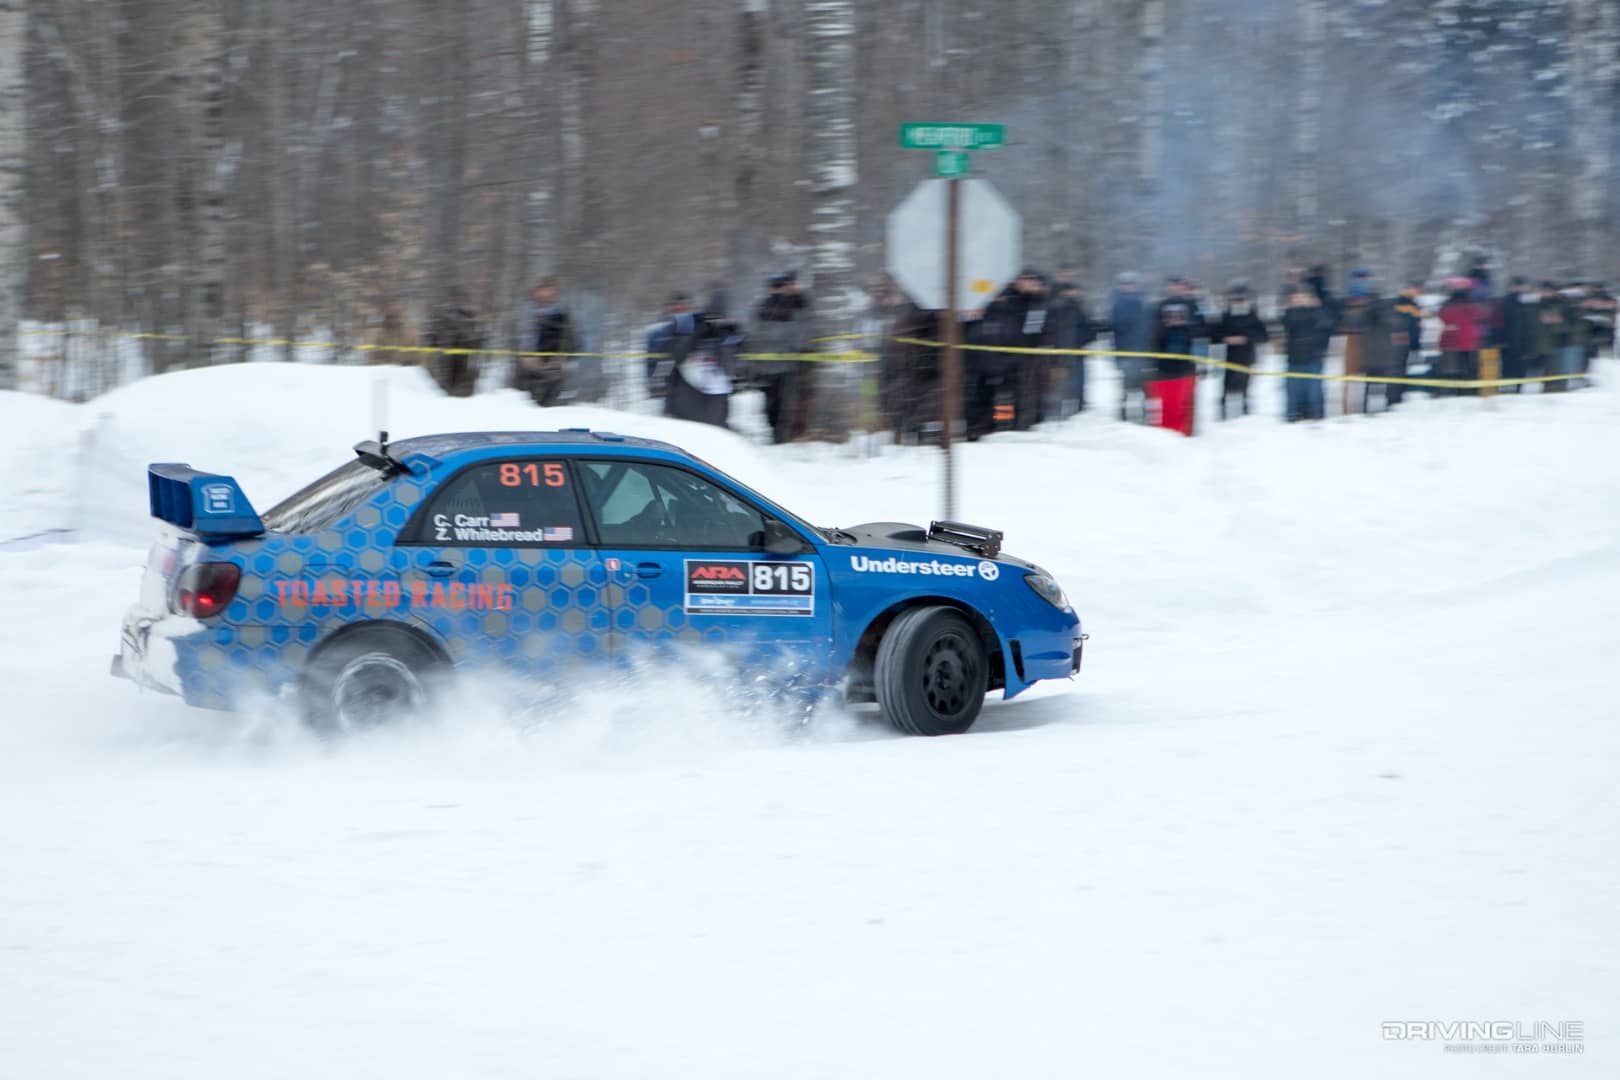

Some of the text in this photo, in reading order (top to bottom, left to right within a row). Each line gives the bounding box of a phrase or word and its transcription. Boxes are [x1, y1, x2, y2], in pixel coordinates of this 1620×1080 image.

[499, 462, 565, 487] 815
[433, 513, 490, 527] C. Carr
[434, 527, 544, 542] Z. Whitebread
[690, 565, 747, 579] ARA
[850, 555, 977, 577] Understeer
[754, 565, 811, 591] 815
[273, 579, 513, 611] TOASTED RACING
